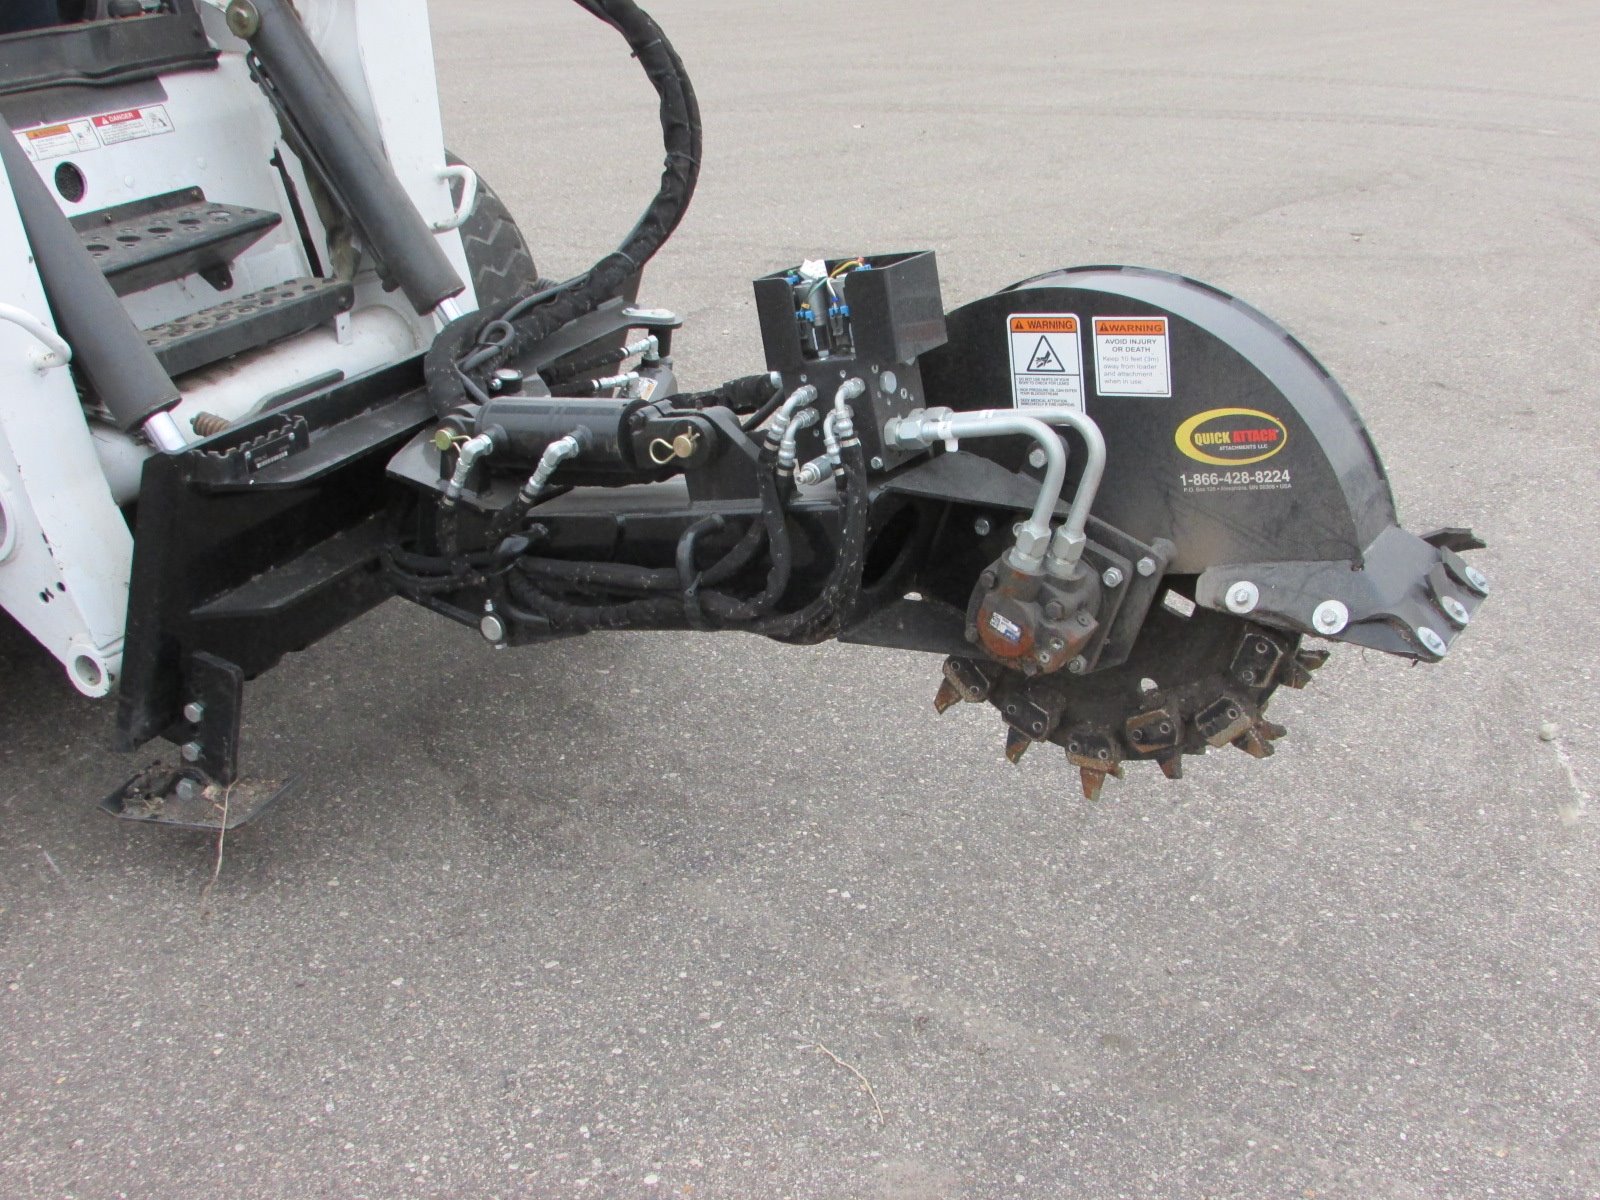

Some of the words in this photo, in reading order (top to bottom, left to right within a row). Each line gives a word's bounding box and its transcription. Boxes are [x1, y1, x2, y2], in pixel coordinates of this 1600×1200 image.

[109, 112, 134, 122] DANGER
[1027, 320, 1073, 329] WARNING
[1194, 432, 1231, 446] QUICK
[1233, 428, 1277, 443] ATTACH
[1180, 470, 1290, 486] 1-866-428-8224
